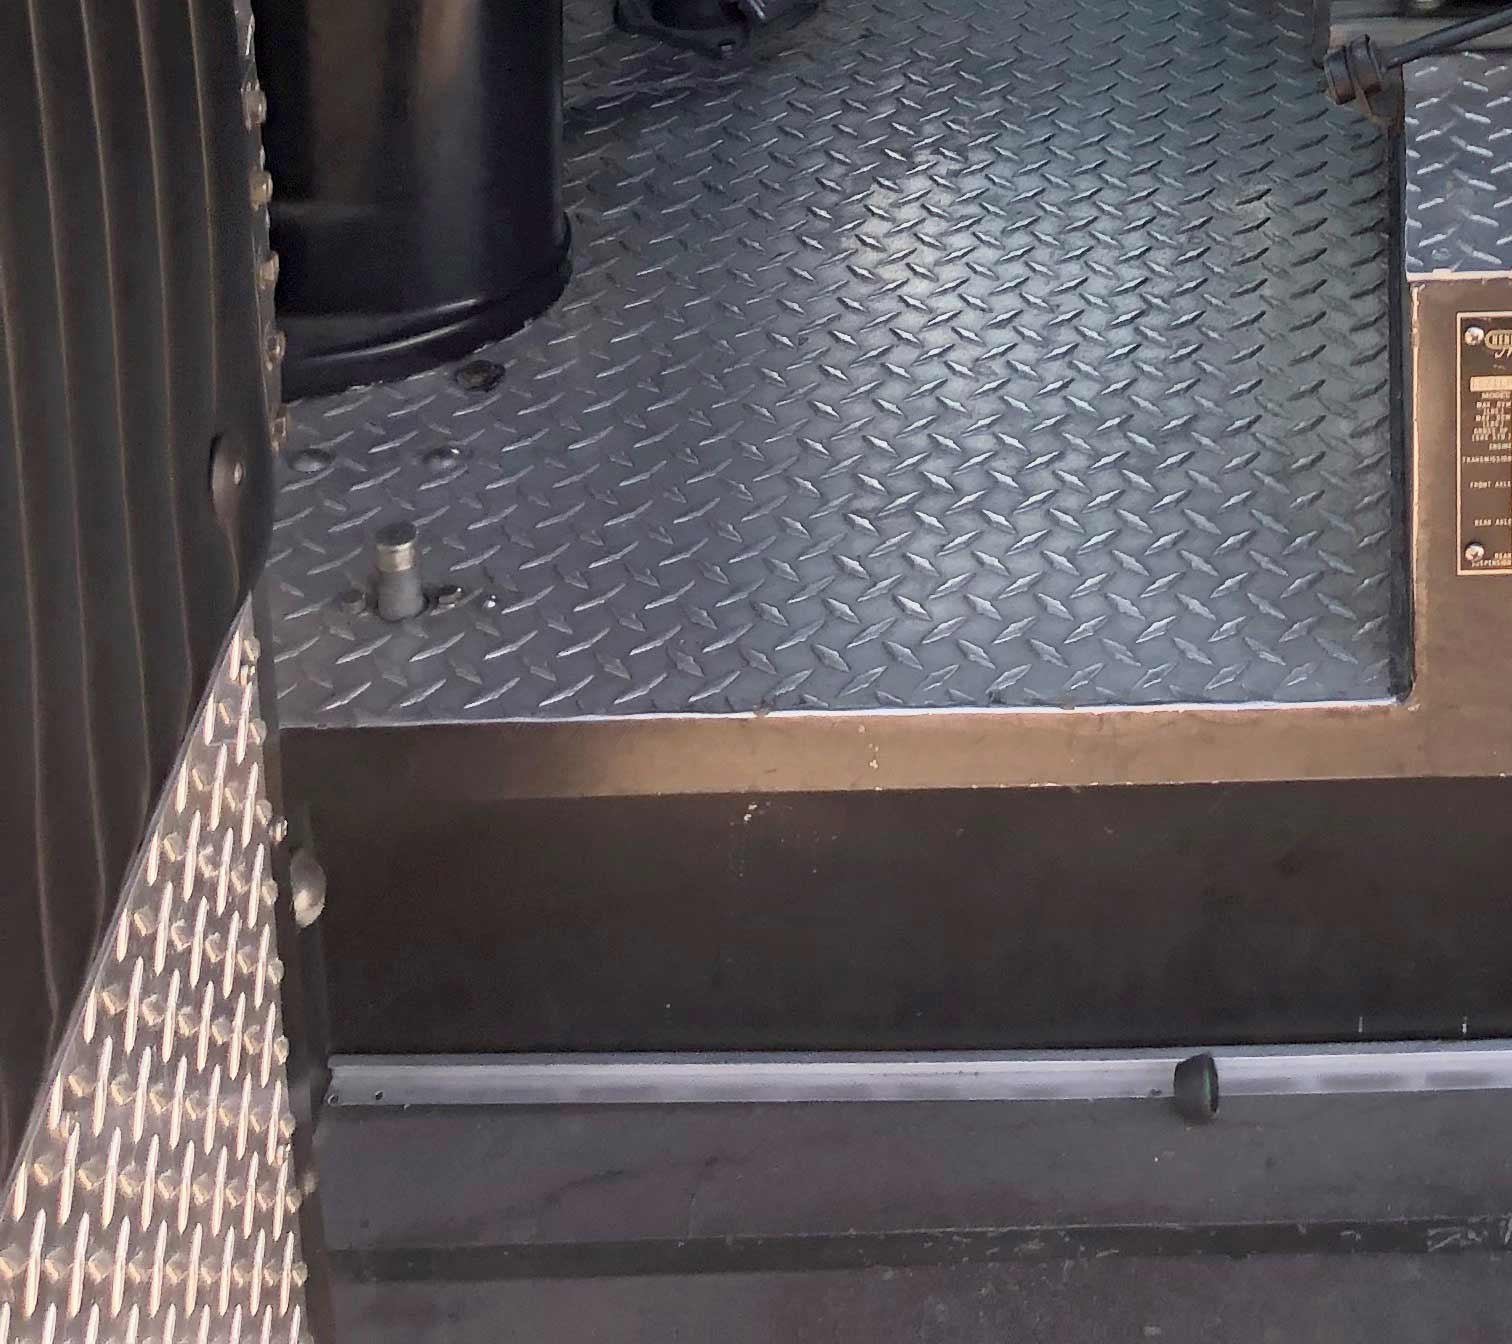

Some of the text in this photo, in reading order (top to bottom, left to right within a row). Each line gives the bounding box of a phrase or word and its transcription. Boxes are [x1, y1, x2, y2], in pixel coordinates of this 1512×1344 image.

[1481, 391, 1511, 399] MODEL
[1462, 455, 1512, 464] TRANSMISSION
[1470, 480, 1512, 489] FRONT AXLE
[1495, 518, 1512, 526] AXLE
